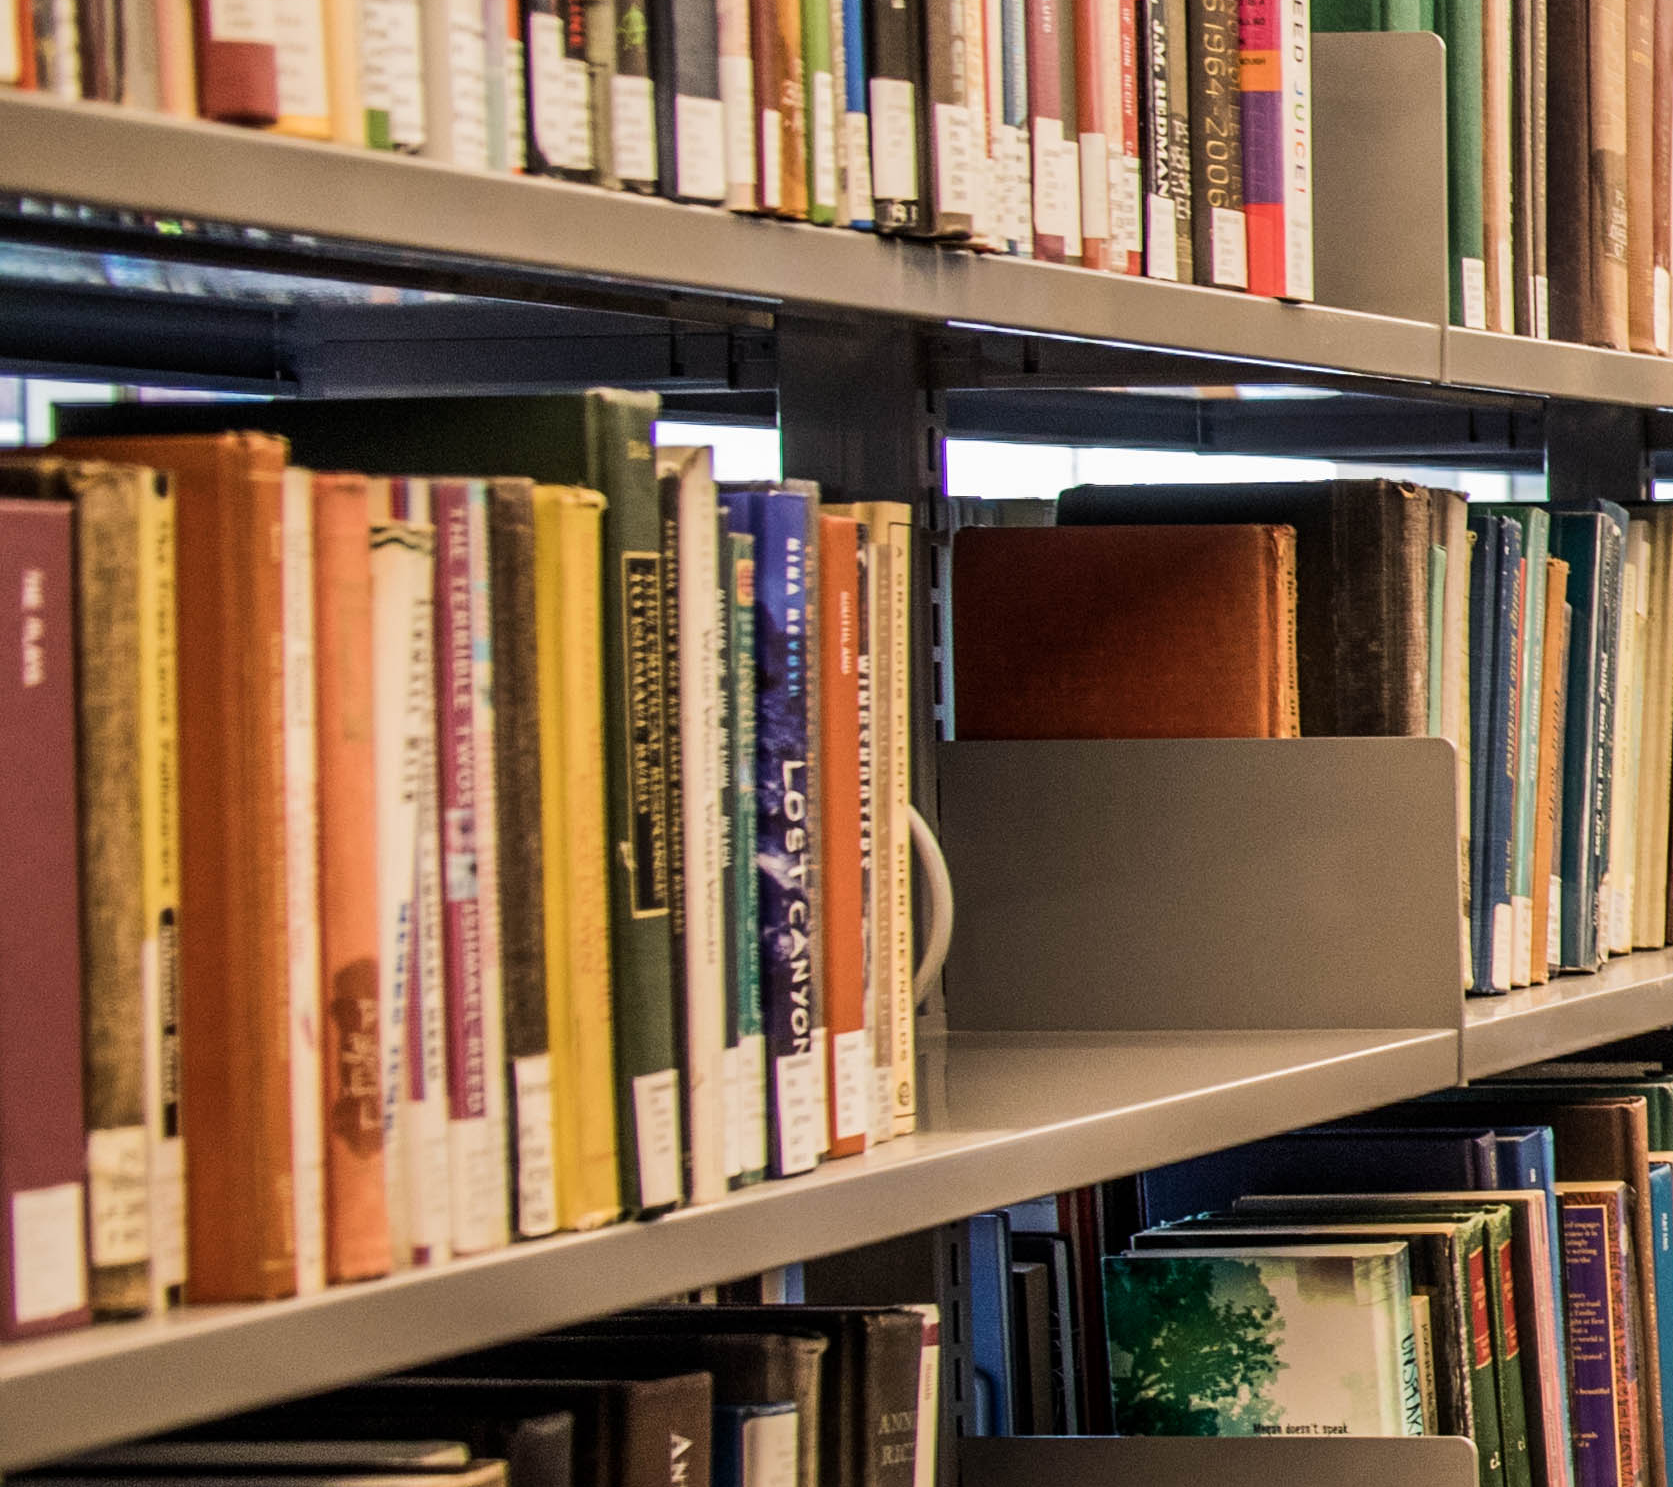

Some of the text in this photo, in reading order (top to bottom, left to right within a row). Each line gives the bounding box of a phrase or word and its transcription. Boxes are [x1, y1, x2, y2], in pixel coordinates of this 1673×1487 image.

[1151, 19, 1170, 70] J.M.
[1153, 77, 1173, 197] REDMAN
[1203, 22, 1229, 207] 1964-2006
[1292, 83, 1307, 194] JUICE!
[1593, 654, 1609, 856] Philip Roth and the Jews
[785, 759, 808, 885] LOST
